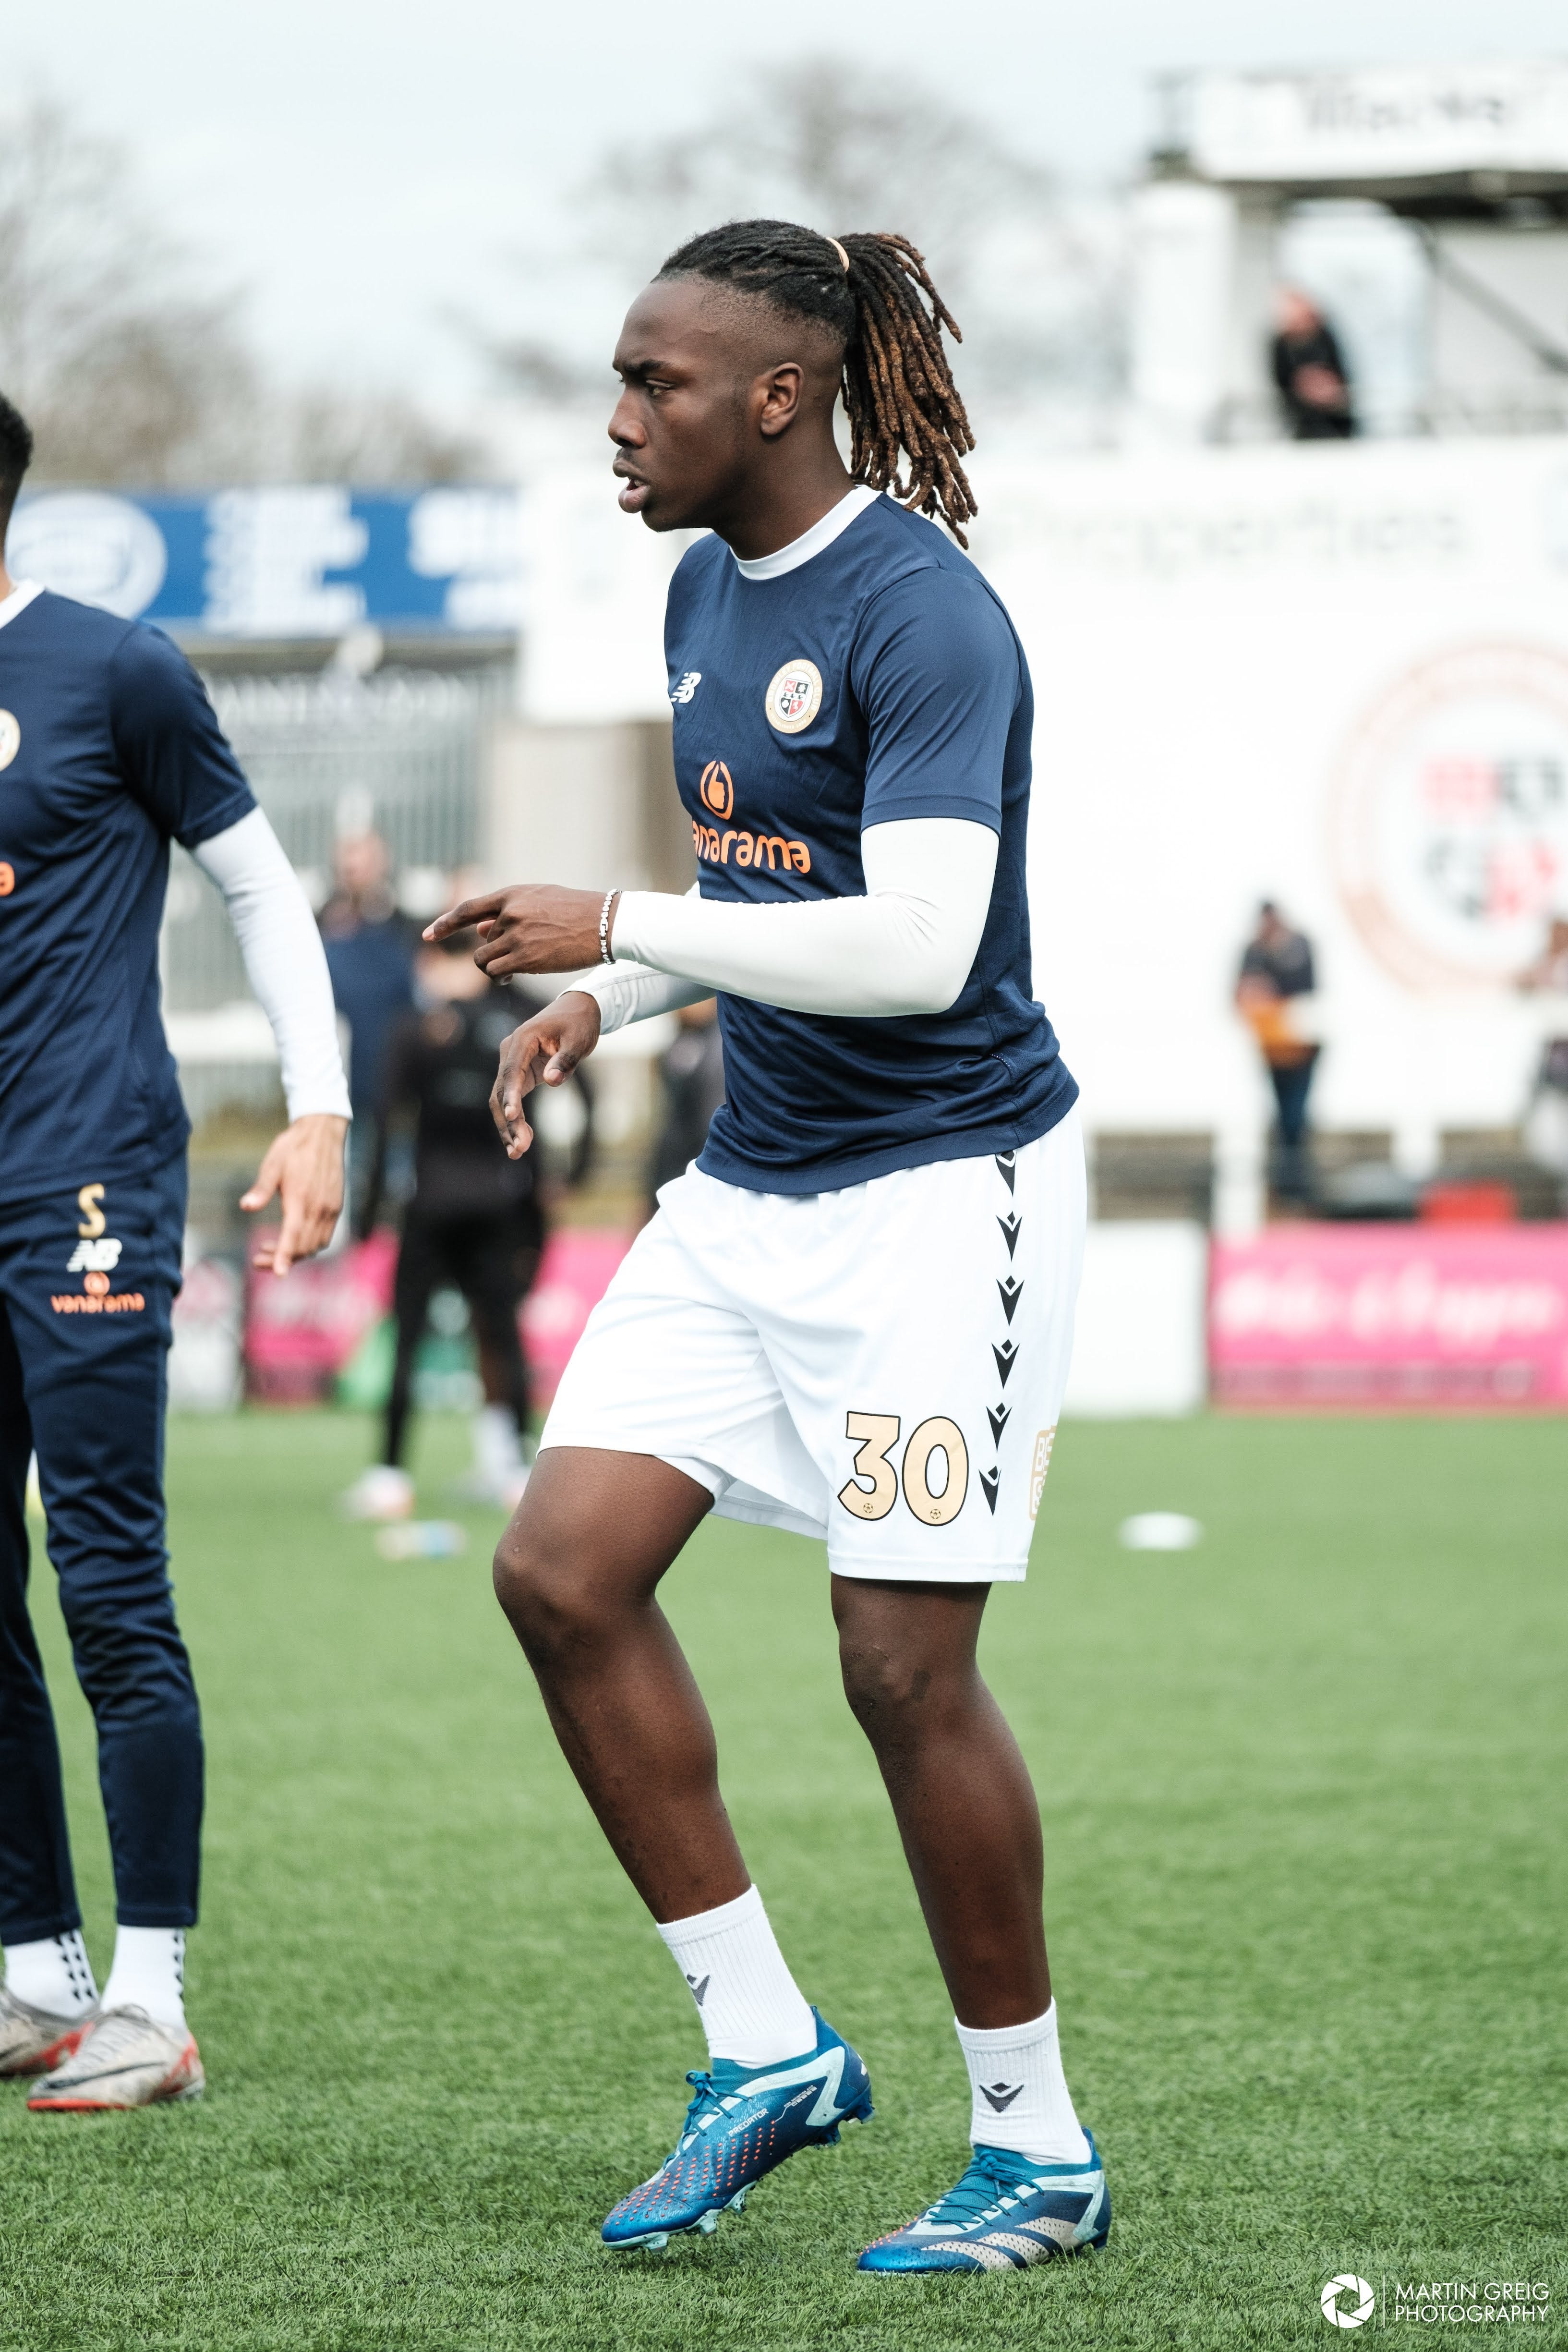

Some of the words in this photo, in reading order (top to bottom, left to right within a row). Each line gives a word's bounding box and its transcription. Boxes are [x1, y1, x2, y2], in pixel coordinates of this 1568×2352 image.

[692, 820, 811, 874] anarama
[837, 1410, 969, 1527] 30
[728, 2108, 769, 2137] PREDATOR
